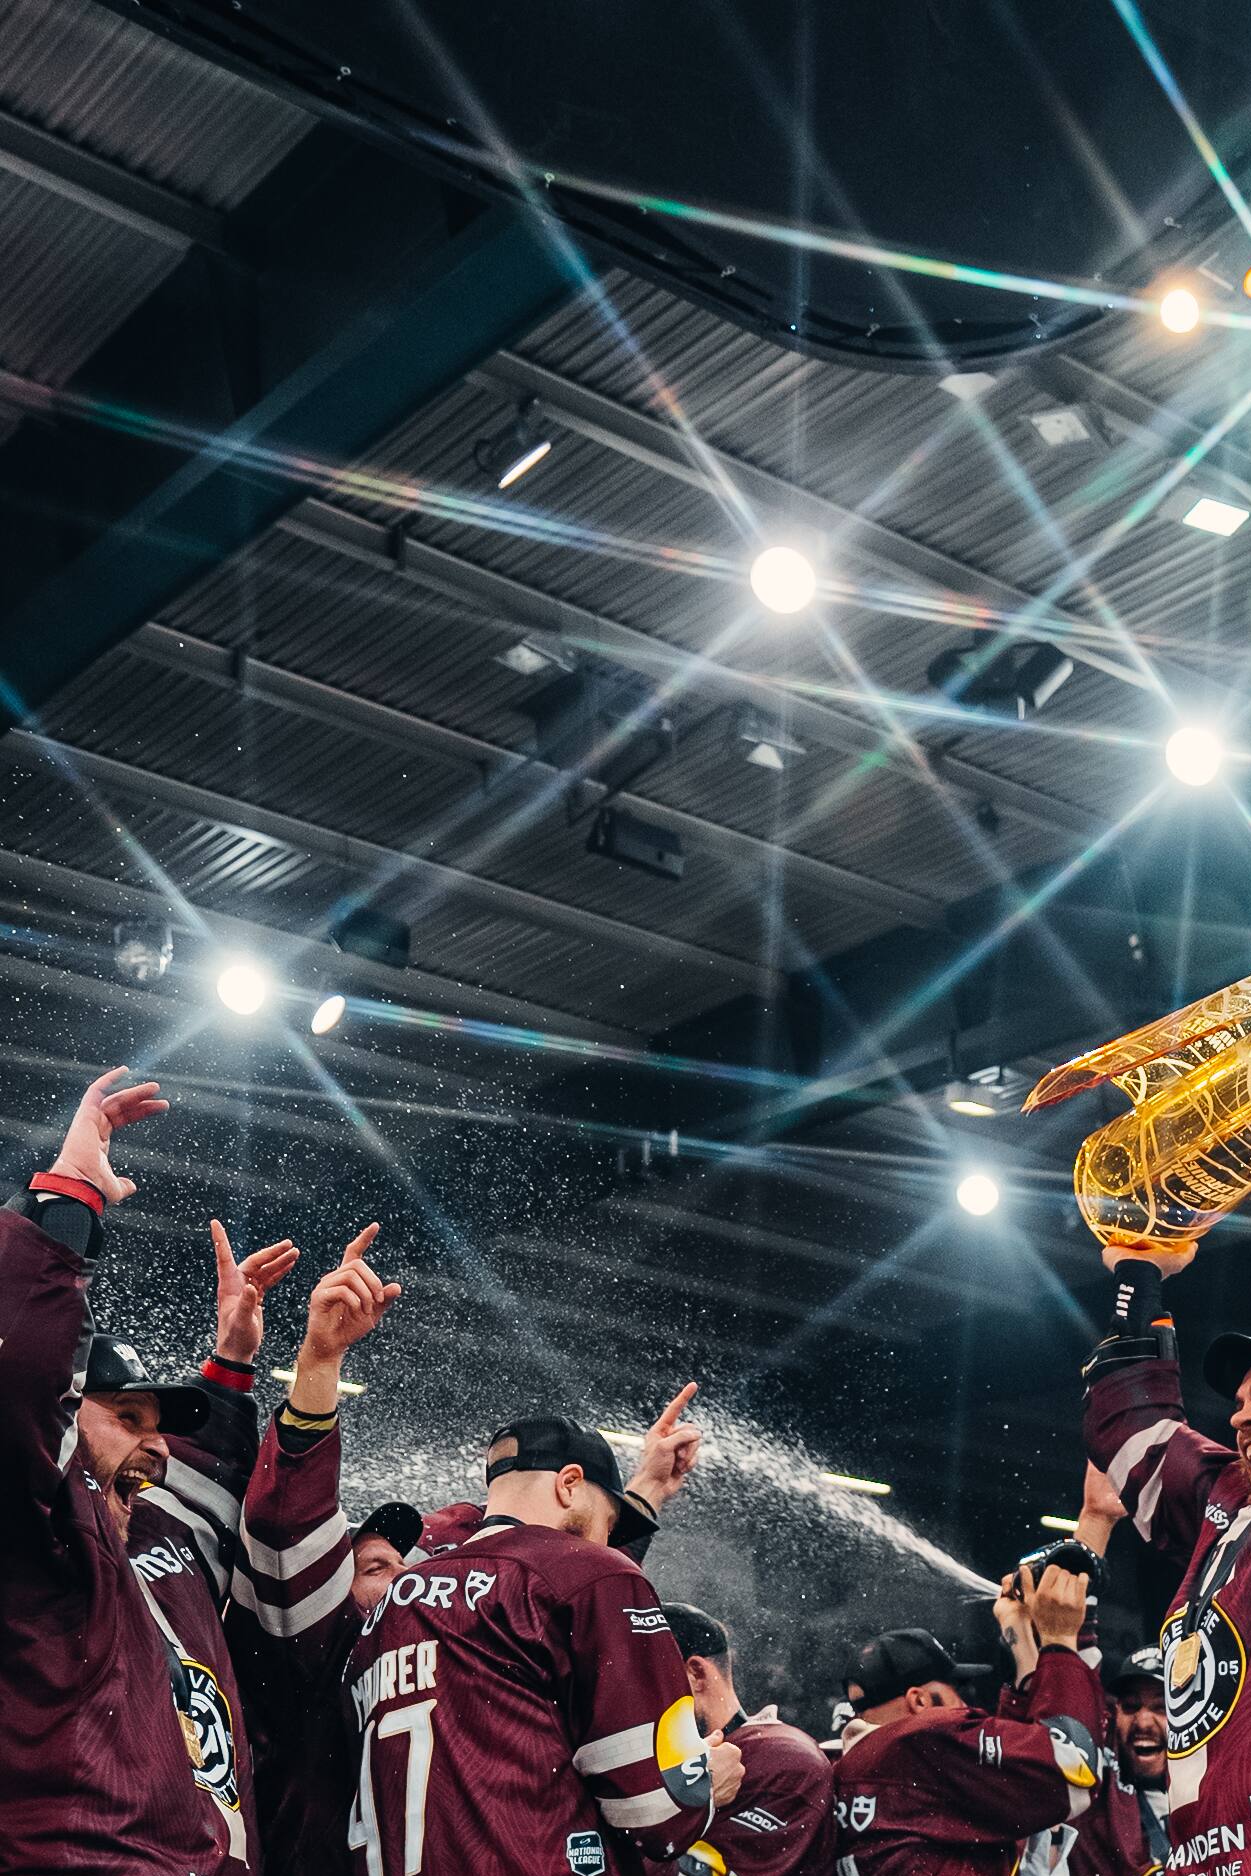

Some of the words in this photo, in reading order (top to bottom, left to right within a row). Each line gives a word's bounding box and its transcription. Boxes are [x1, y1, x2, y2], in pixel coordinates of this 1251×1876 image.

[630, 1613, 667, 1628] ŠKOD
[1217, 1660, 1239, 1676] 05
[1167, 1702, 1224, 1750] RVETTE
[568, 1847, 603, 1856] NATIONAL
[572, 1855, 602, 1865] LEAGUE
